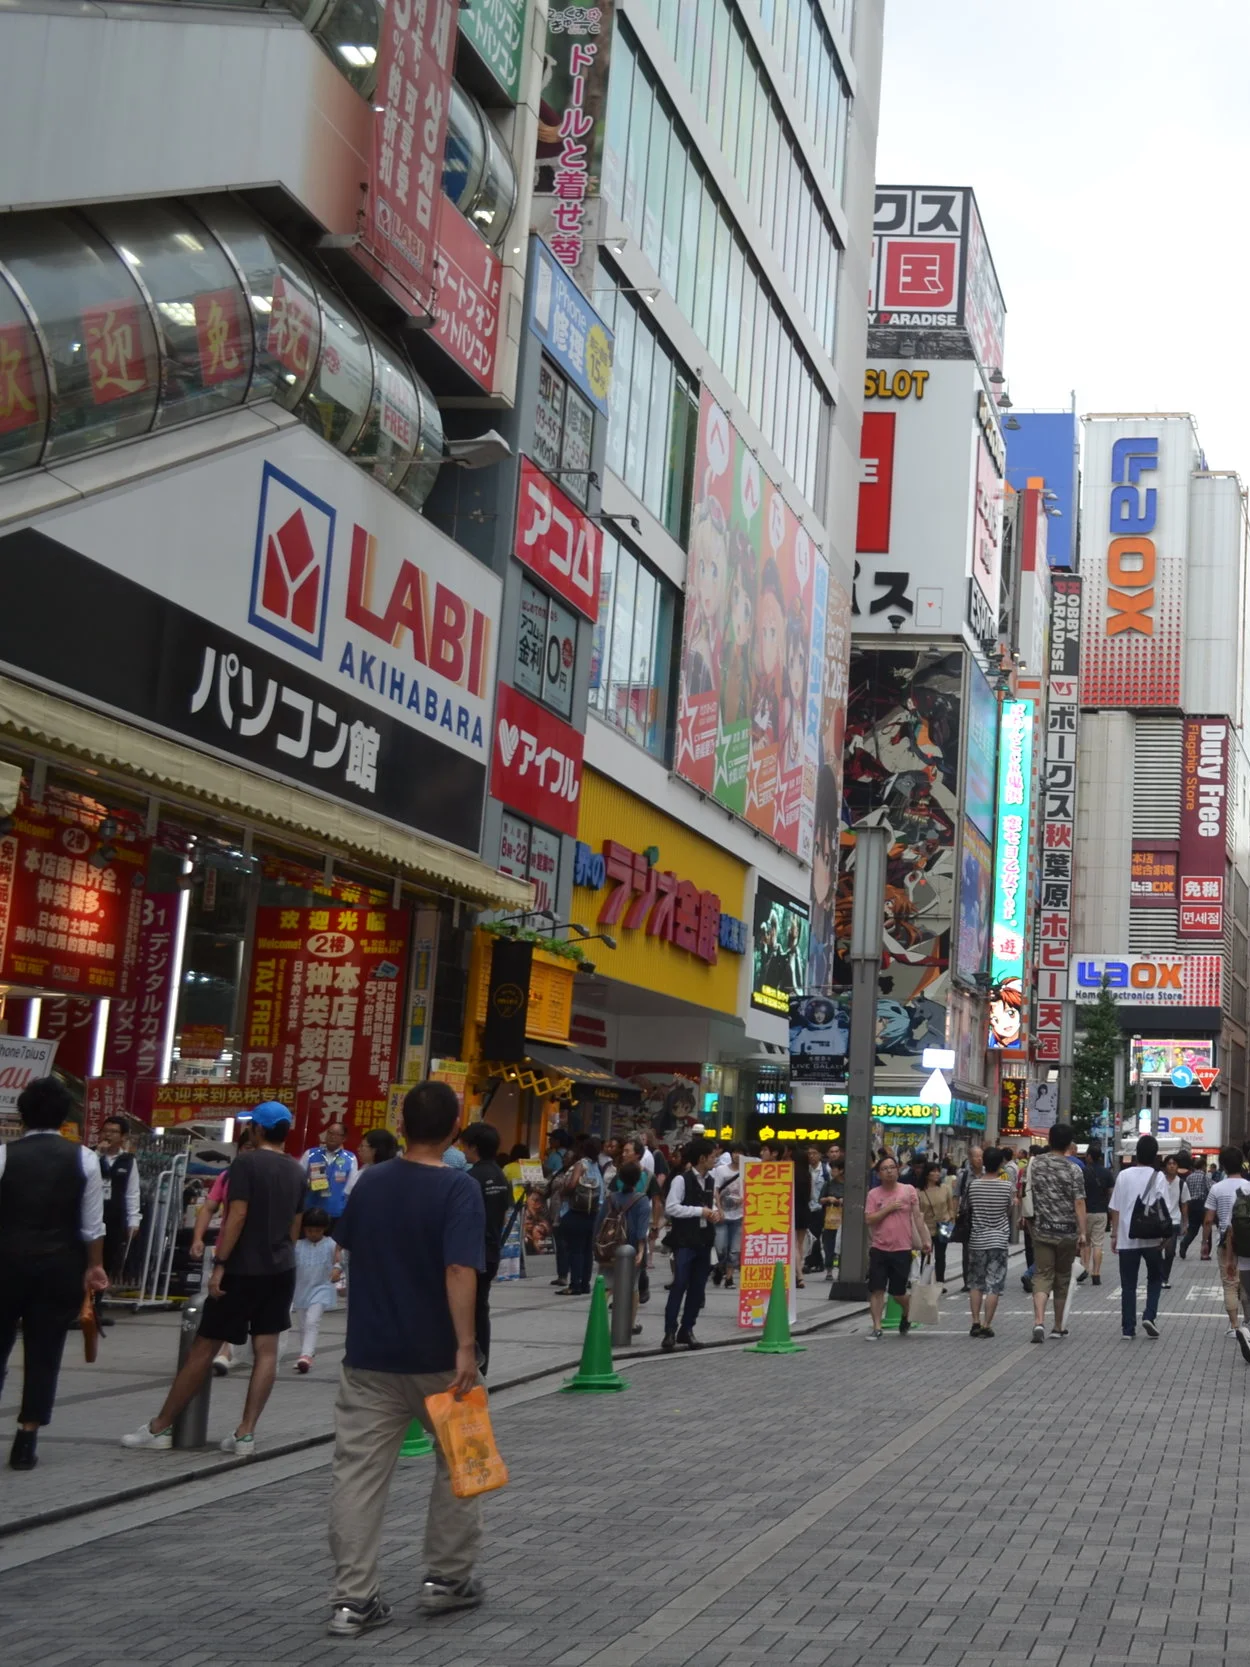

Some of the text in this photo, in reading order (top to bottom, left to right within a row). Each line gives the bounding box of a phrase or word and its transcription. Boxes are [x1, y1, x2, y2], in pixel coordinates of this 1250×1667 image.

[879, 312, 958, 326] PARADISE
[863, 369, 930, 400] SLOT
[383, 405, 411, 446] FREE
[523, 481, 598, 598] アコム
[345, 523, 491, 699] LABI
[1051, 580, 1067, 672] PARADISE
[1066, 580, 1080, 643] HOBBY
[191, 645, 381, 794] パソコン館
[339, 642, 484, 749] AKIHABARA
[518, 730, 580, 803] アイフル
[1184, 724, 1200, 811] Flagship Store
[1196, 724, 1228, 838] Duty Free
[1184, 880, 1221, 899] 免税
[257, 936, 302, 951] Welcome!
[279, 910, 387, 931] 欢迎光临
[313, 935, 346, 953] 2楼
[1182, 911, 1220, 926] 면세점
[136, 931, 169, 1076] デジタルカメラ
[249, 957, 276, 1048] TAX FREE
[1103, 989, 1155, 1000] lectronics
[1157, 989, 1183, 1001] Store
[763, 1164, 791, 1180] 2F
[744, 1183, 792, 1234] 薬
[744, 1233, 789, 1257] 药品
